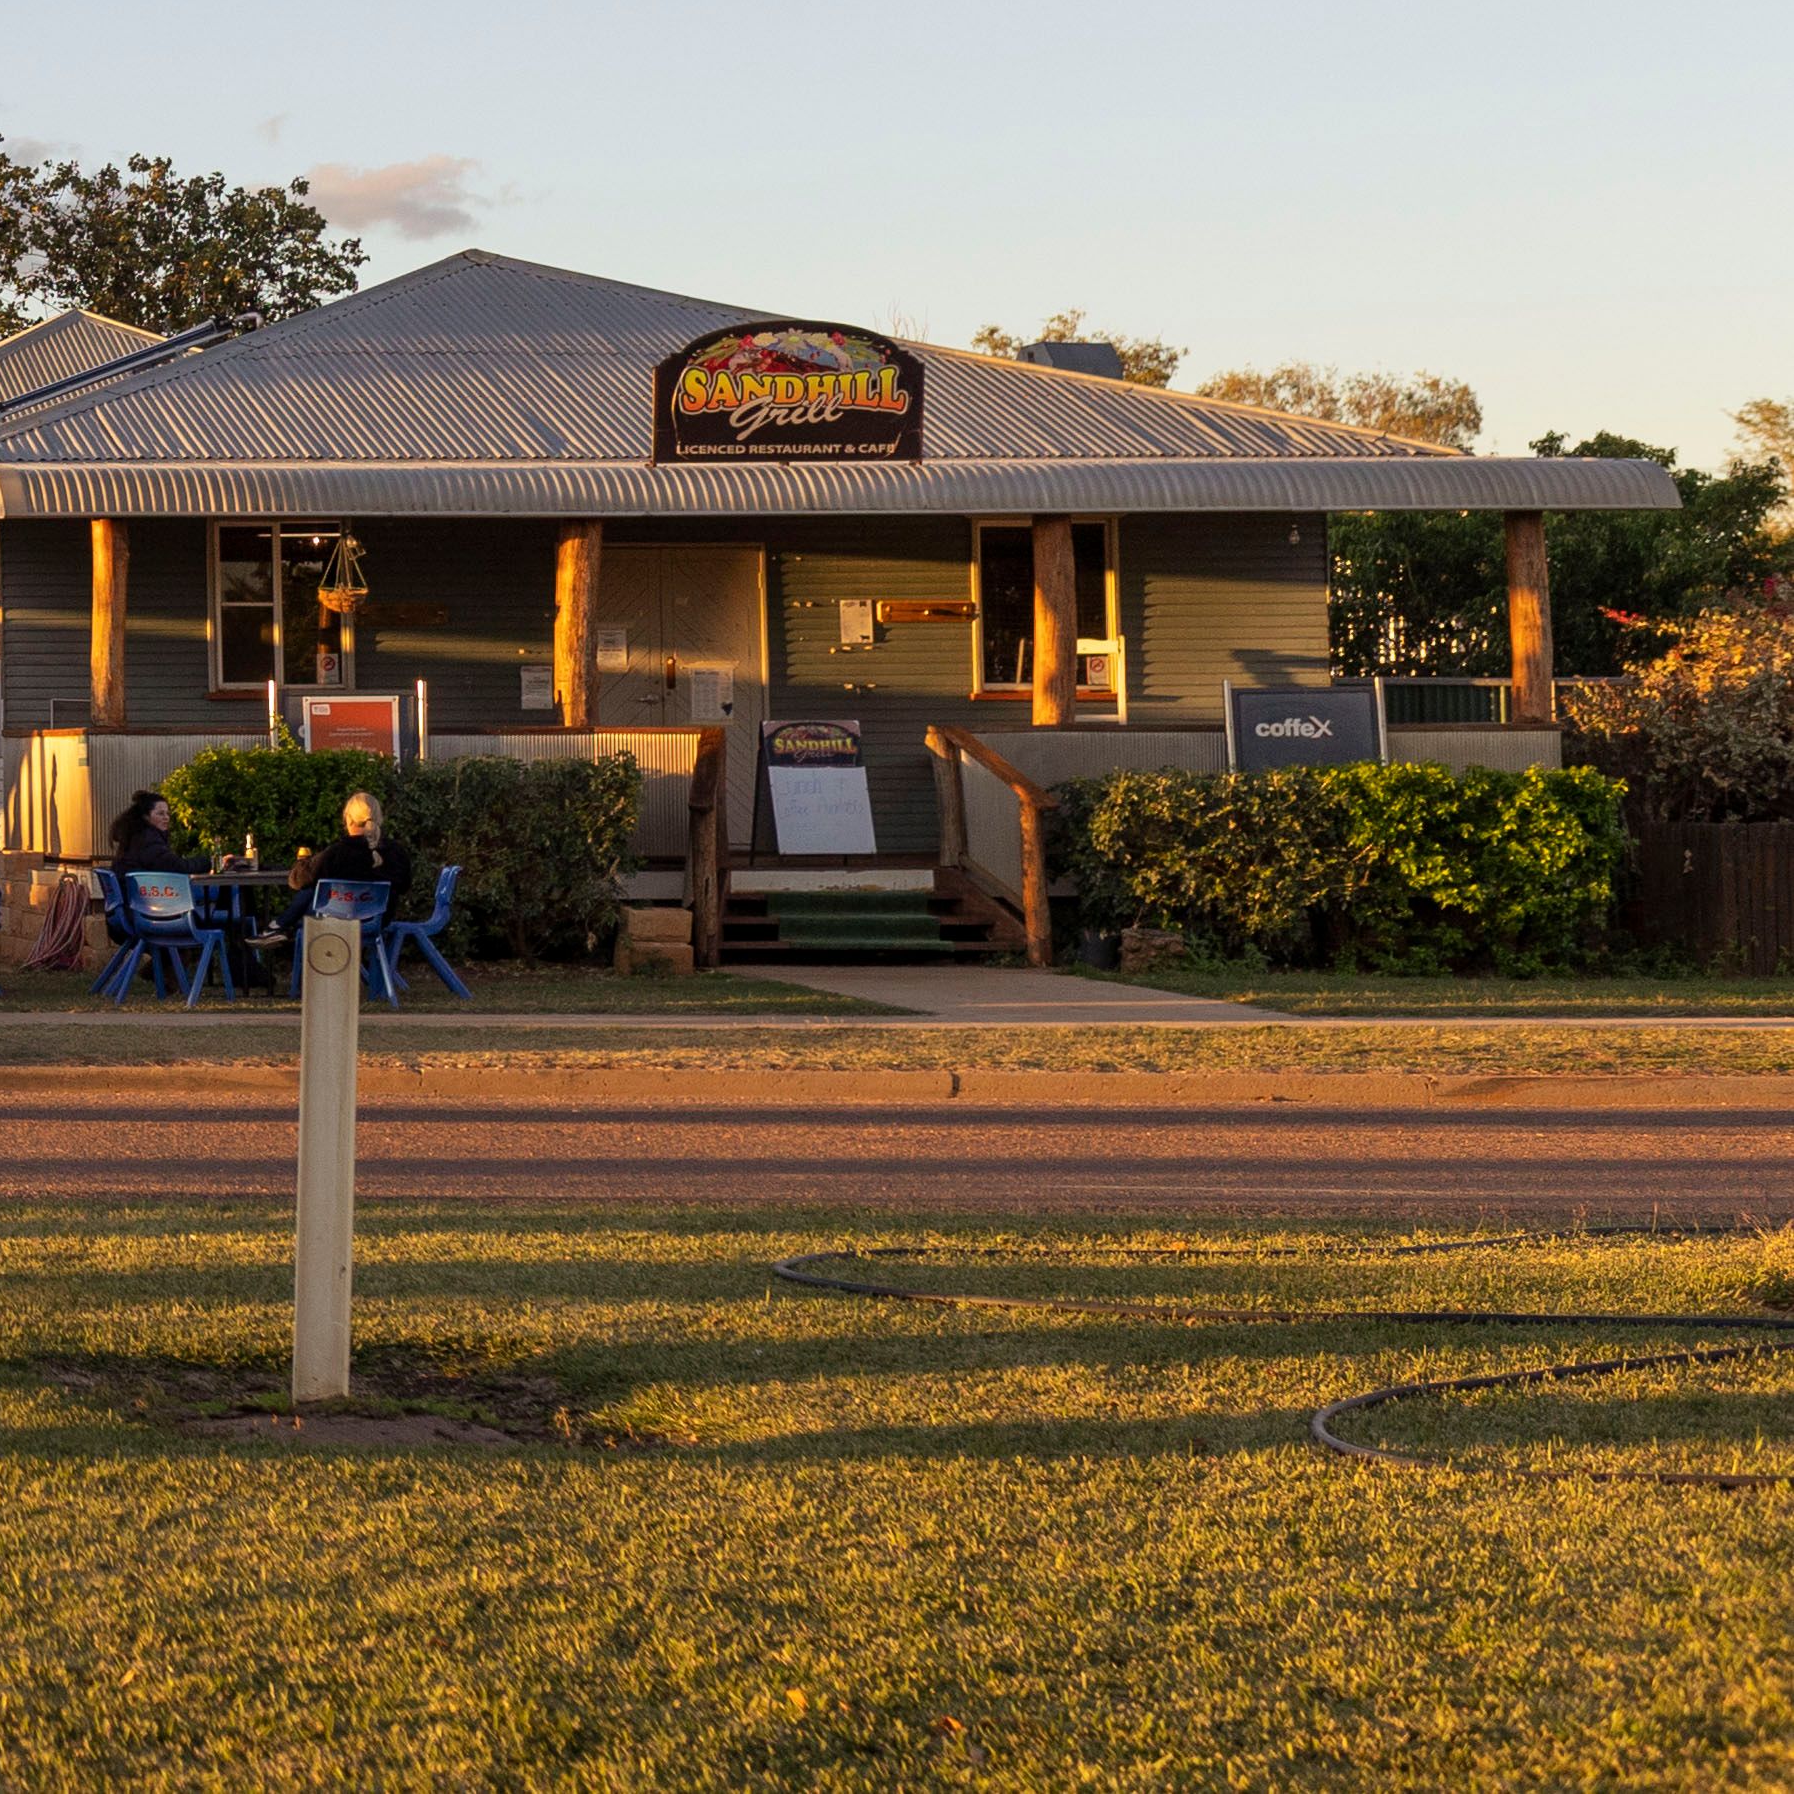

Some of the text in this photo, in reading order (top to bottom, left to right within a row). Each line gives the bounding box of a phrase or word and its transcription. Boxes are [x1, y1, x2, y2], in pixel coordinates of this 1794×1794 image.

[680, 366, 907, 414] SANDHILL
[729, 393, 844, 442] Grill
[676, 443, 747, 455] LICENCED
[749, 444, 842, 455] RESTAURANT
[844, 443, 856, 455] &
[774, 737, 859, 755] SANDHILL
